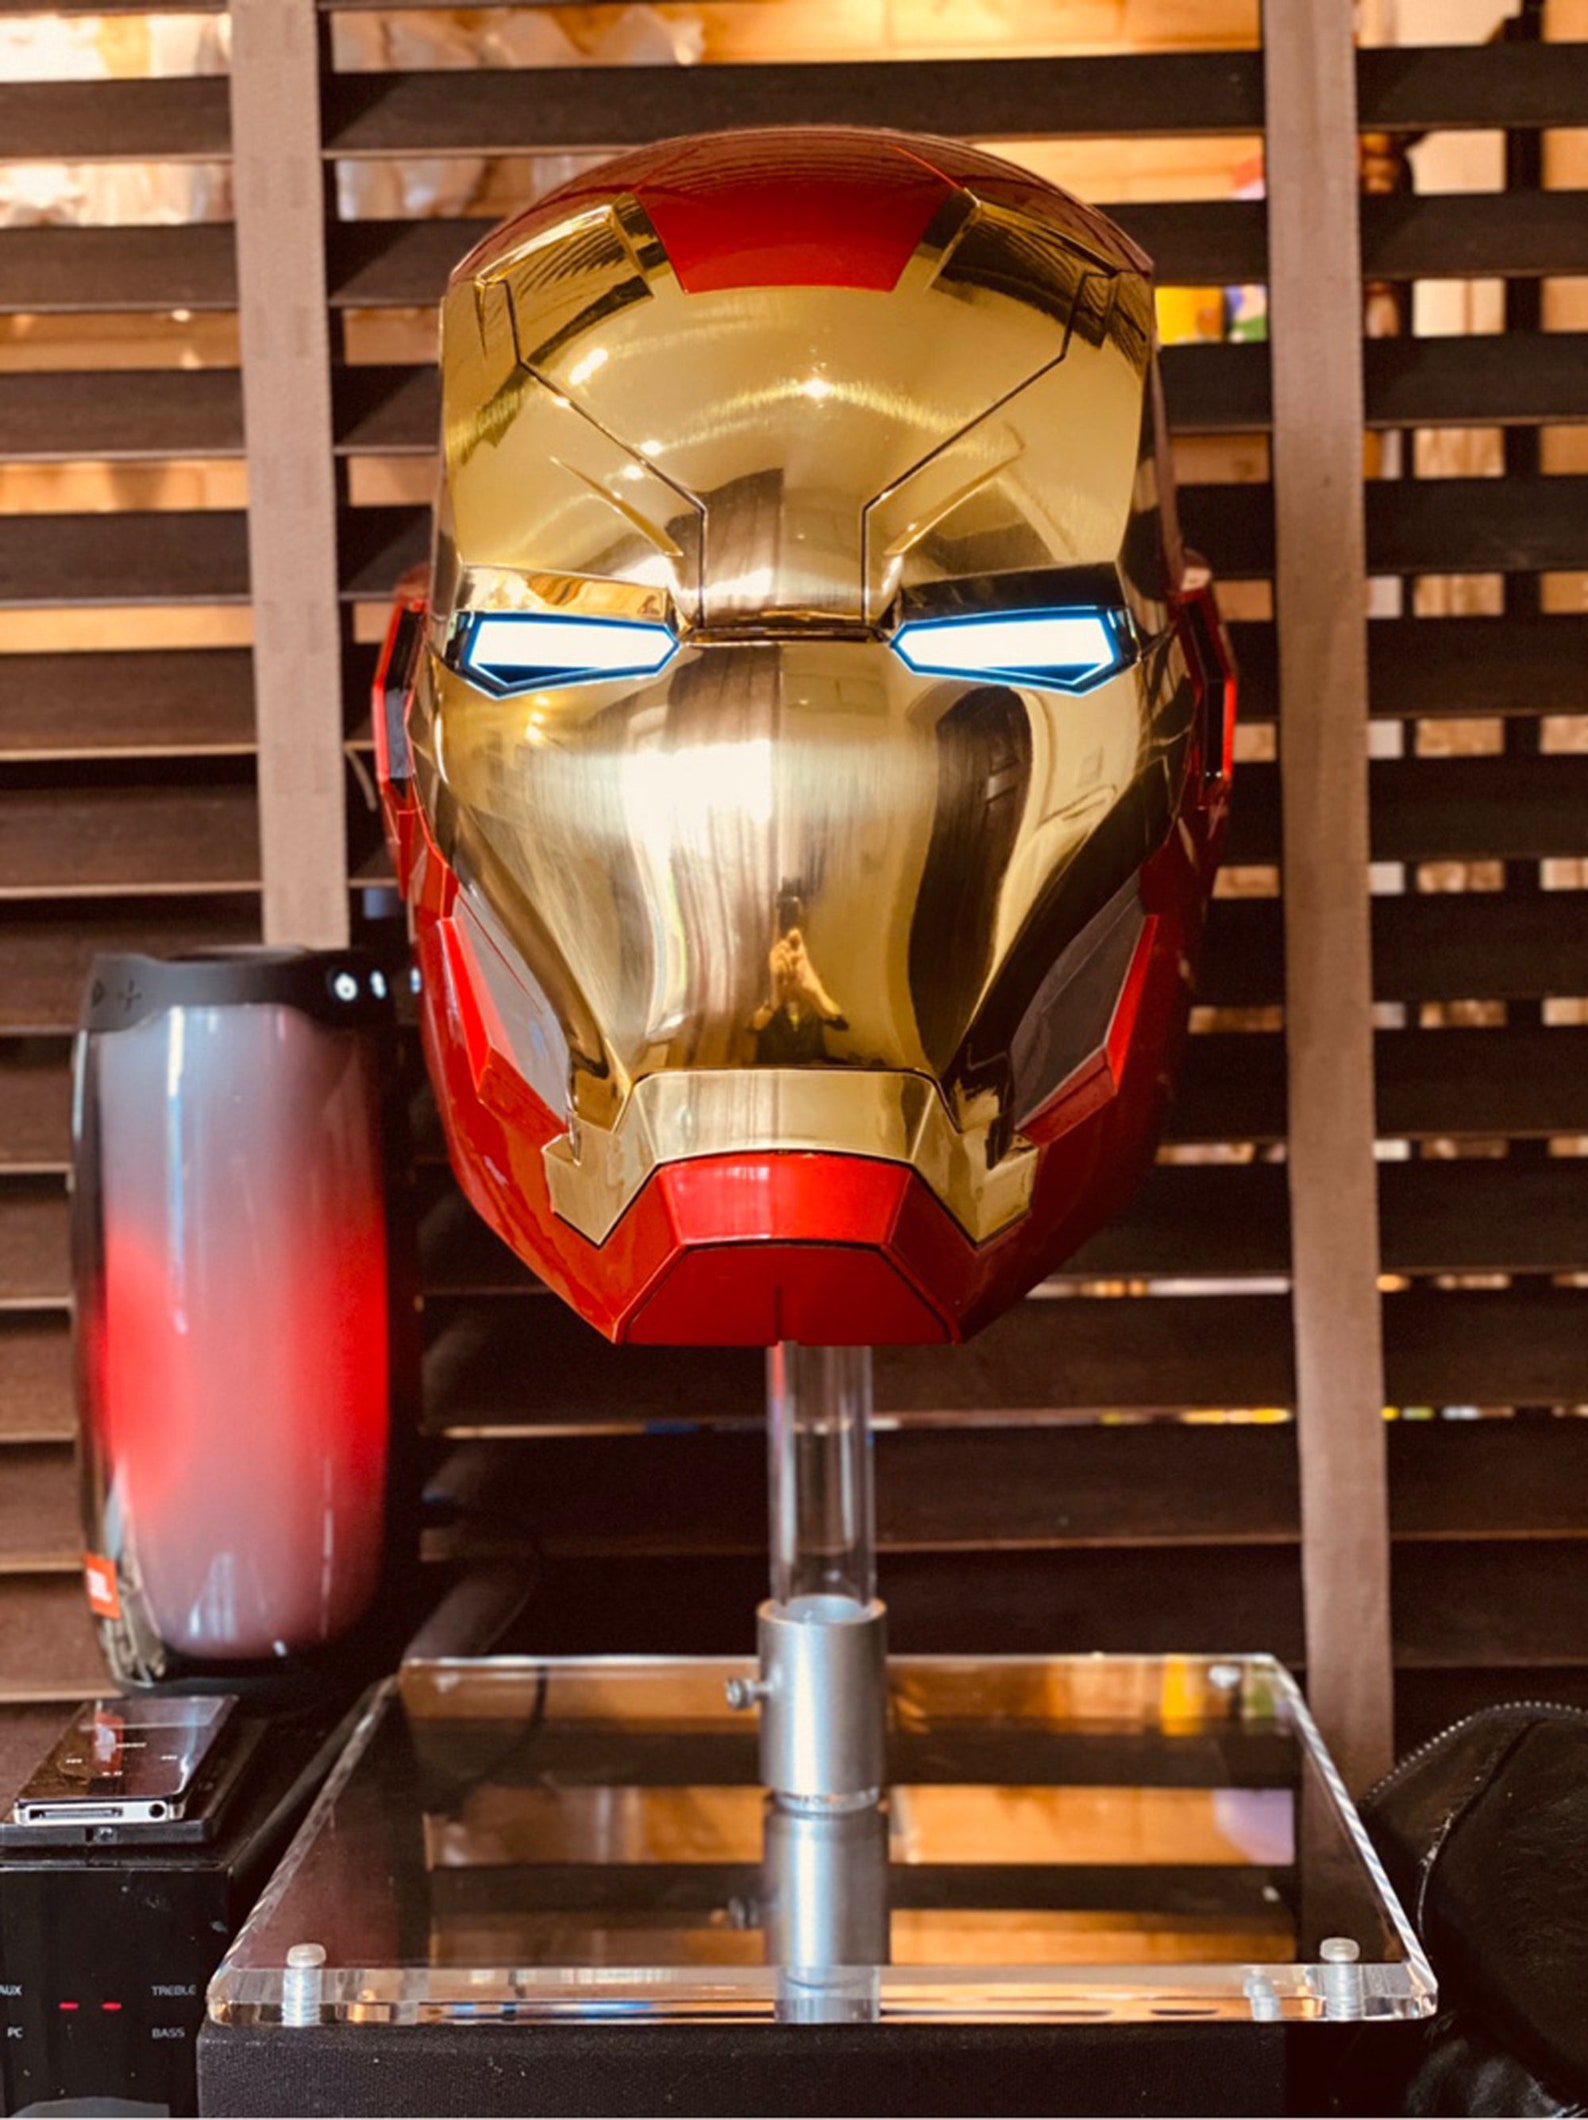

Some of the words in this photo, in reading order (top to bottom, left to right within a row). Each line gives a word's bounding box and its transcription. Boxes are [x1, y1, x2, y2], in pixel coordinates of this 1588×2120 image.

[0, 1984, 22, 1997] AUX
[151, 1984, 197, 1997] TREBLE
[6, 2026, 24, 2039] PC
[151, 2026, 186, 2040] BASS
